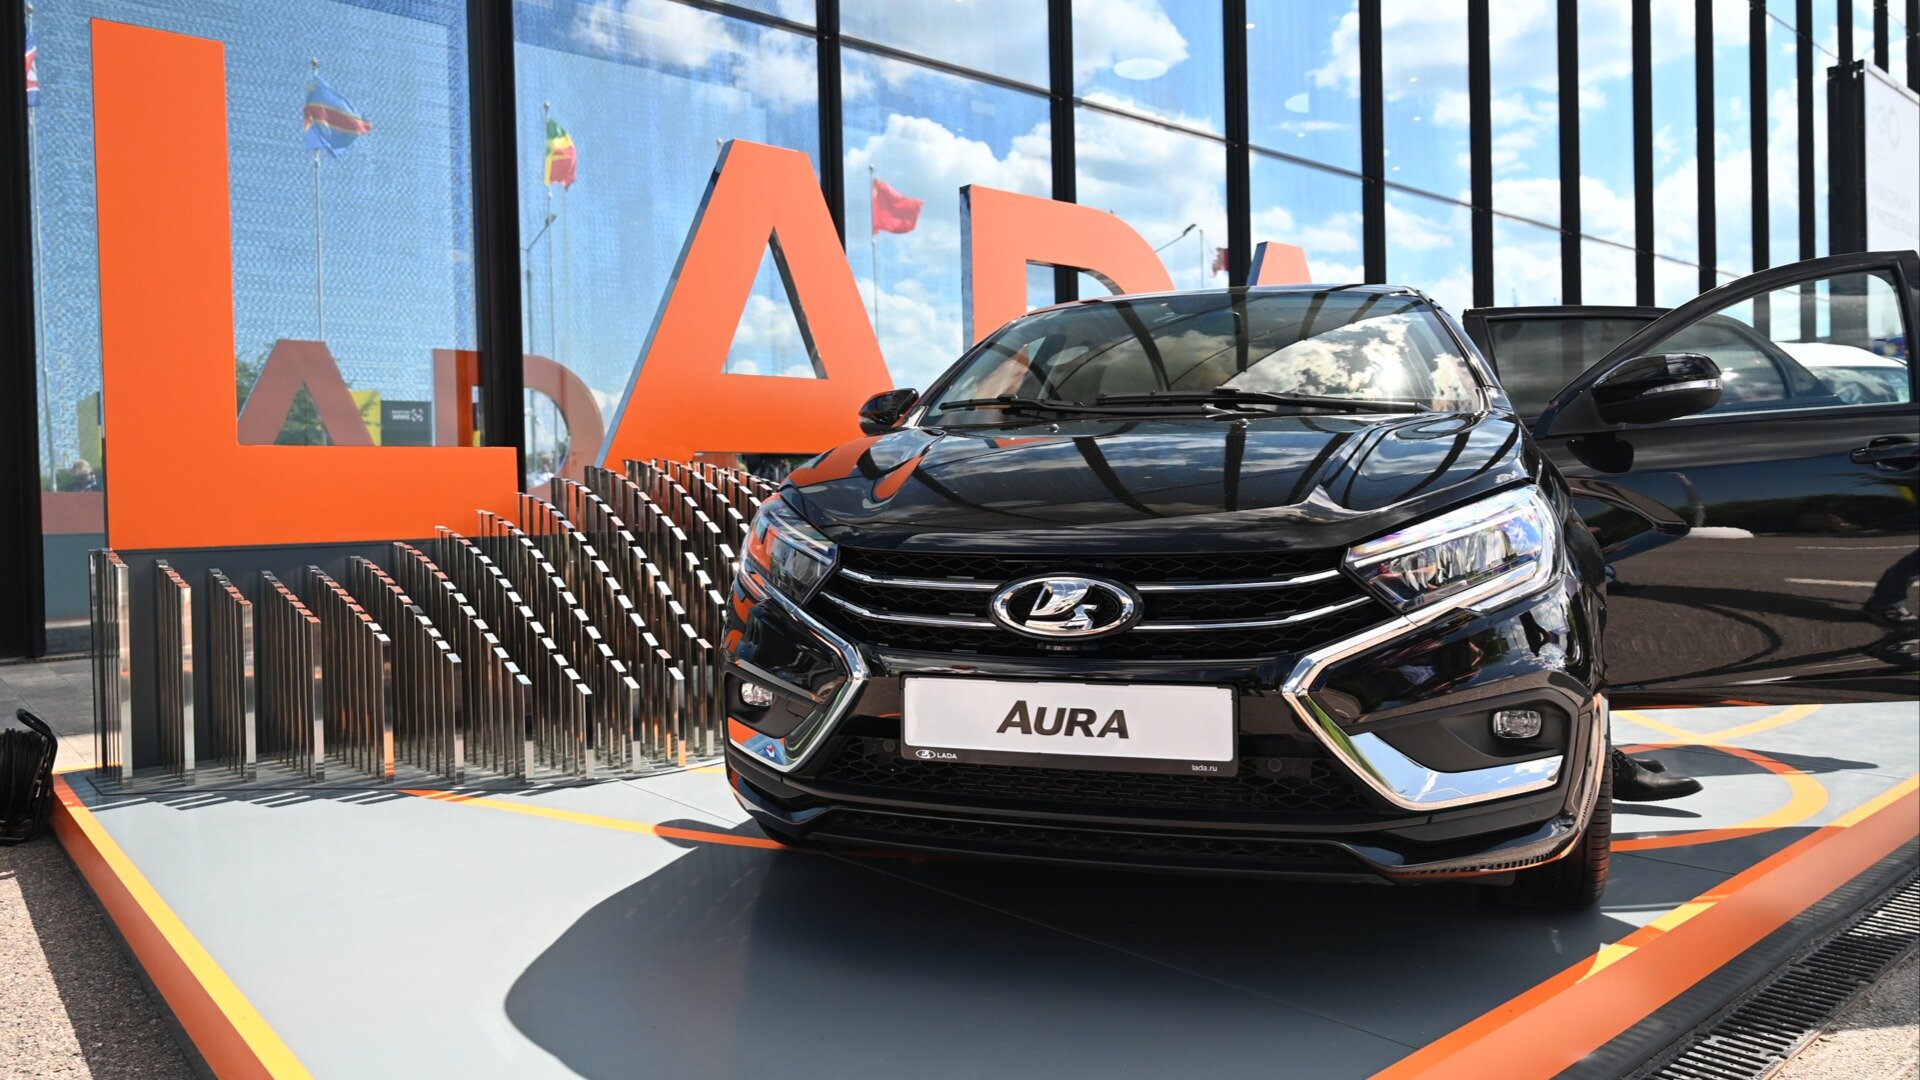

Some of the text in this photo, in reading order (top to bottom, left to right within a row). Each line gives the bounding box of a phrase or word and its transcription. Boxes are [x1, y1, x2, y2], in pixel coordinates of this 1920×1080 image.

[91, 17, 1312, 549] LAD
[996, 700, 1130, 740] AURA
[936, 752, 958, 760] LADA
[1191, 764, 1218, 772] lada.ru
